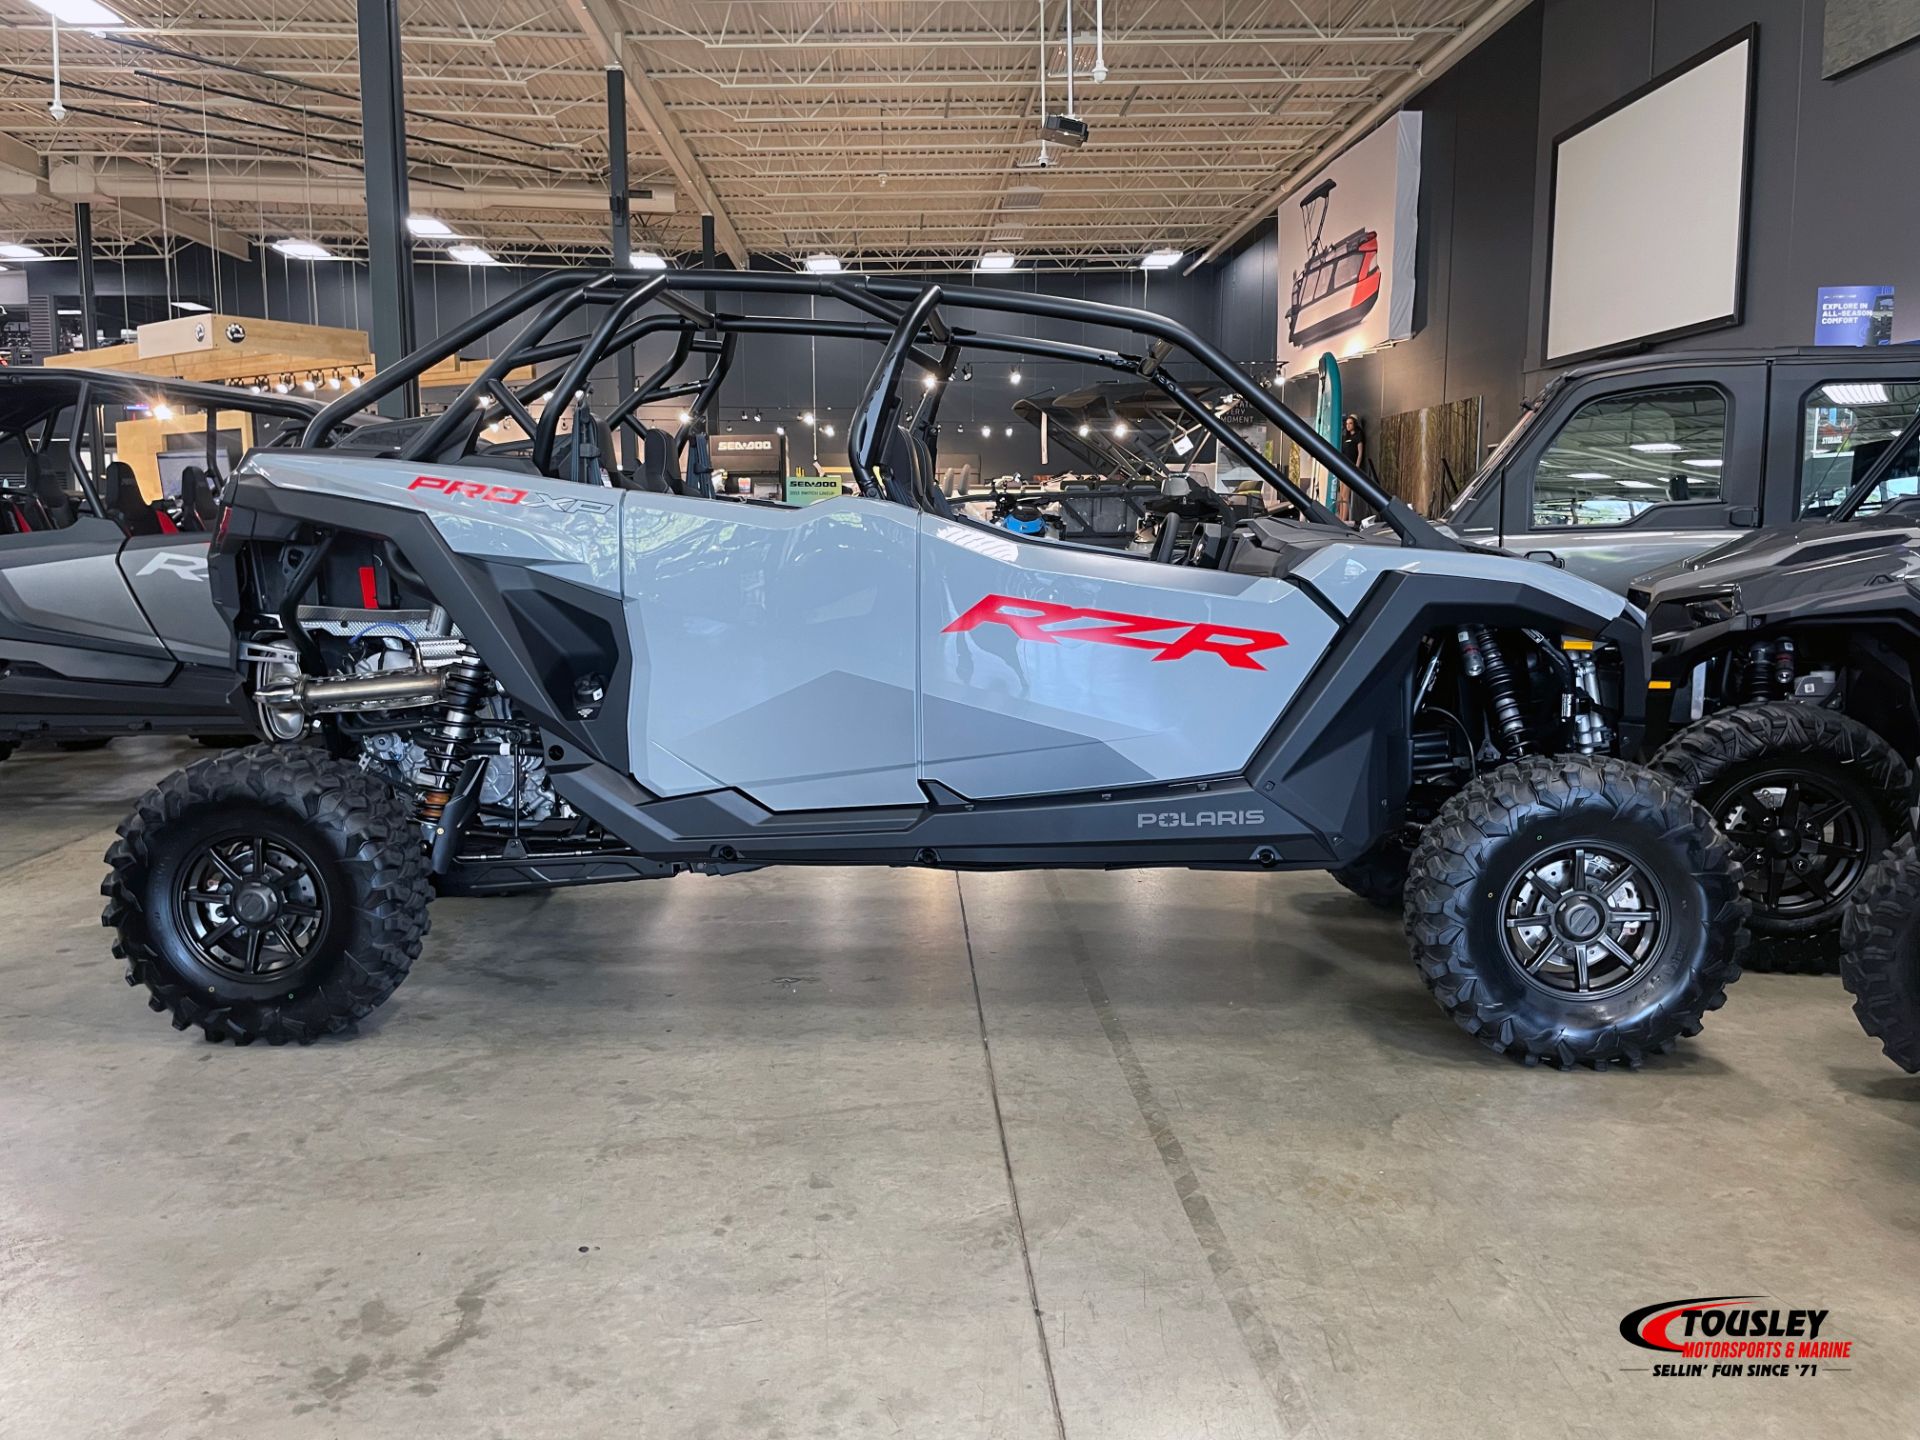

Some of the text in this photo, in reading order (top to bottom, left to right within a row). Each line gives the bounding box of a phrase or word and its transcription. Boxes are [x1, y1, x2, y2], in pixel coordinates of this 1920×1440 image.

[1822, 302, 1868, 310] EXPLORE IN
[1821, 317, 1858, 325] COMFORT
[407, 475, 614, 515] PRO XP
[939, 593, 1290, 671] RZR
[1137, 809, 1265, 828] POLARIS
